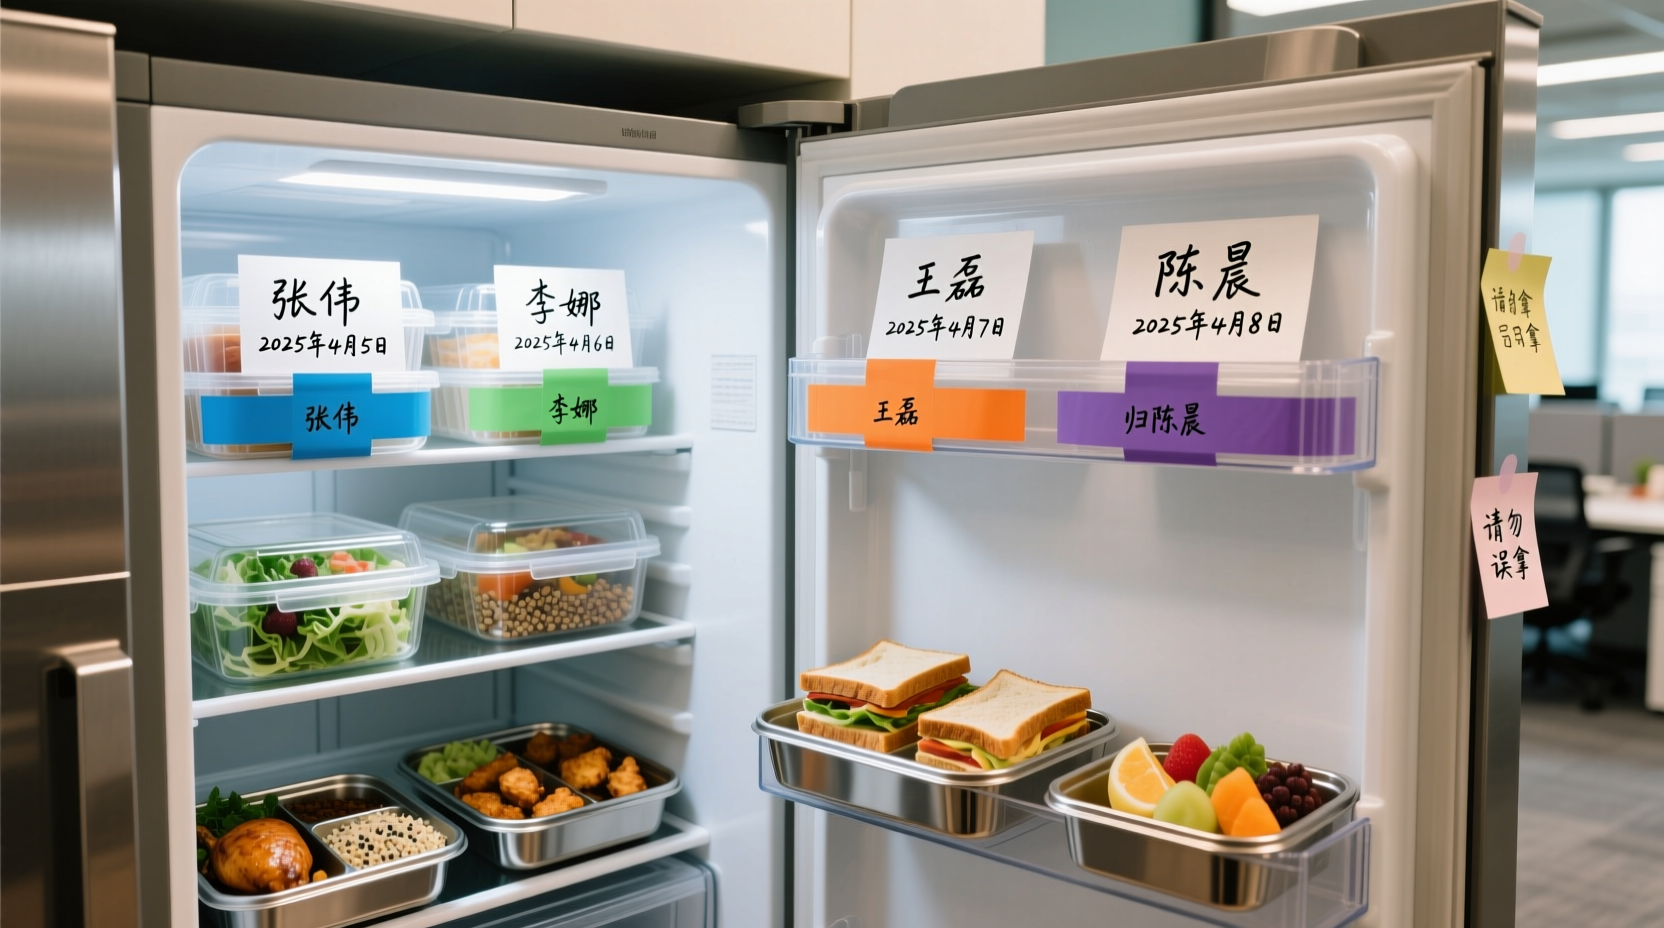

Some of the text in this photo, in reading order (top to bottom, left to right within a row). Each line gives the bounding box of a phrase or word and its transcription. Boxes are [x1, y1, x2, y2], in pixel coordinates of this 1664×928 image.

[907, 253, 985, 303] 王磊
[1154, 240, 1261, 302] 陈晨
[272, 277, 360, 327] 张伟
[526, 278, 601, 327] 李娜
[885, 313, 1004, 342] 2025年4月7日
[1132, 308, 1282, 341] 2025年4月8日
[258, 330, 387, 359] 2025年4月5日
[514, 330, 614, 355] 2025年4月6日
[305, 401, 359, 435] 张伟
[549, 393, 598, 426] 李娜
[873, 396, 919, 426] 王磊
[1125, 402, 1206, 437] 归陈晨
[1483, 507, 1523, 543] 请勿
[1490, 545, 1530, 581] 误拿
